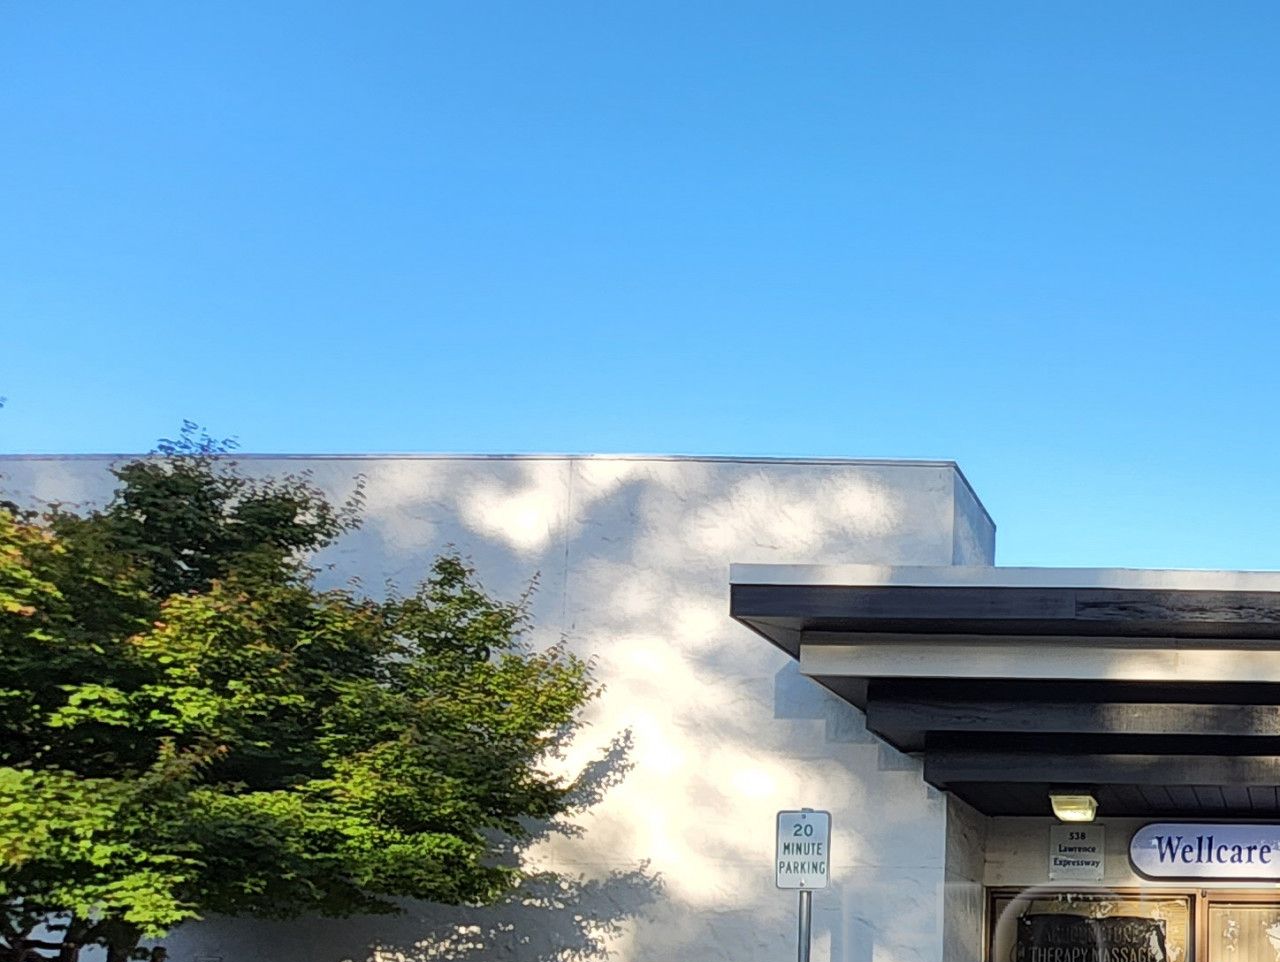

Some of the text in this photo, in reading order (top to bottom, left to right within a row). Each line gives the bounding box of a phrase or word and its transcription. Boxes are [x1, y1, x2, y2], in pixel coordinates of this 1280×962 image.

[793, 823, 814, 837] 20
[1069, 831, 1087, 840] 538
[783, 842, 823, 856] MINUTE
[1058, 843, 1097, 853] Lawrence
[1155, 835, 1272, 865] Wellcare
[779, 861, 826, 874] PARKING
[1053, 857, 1101, 868] Expressway
